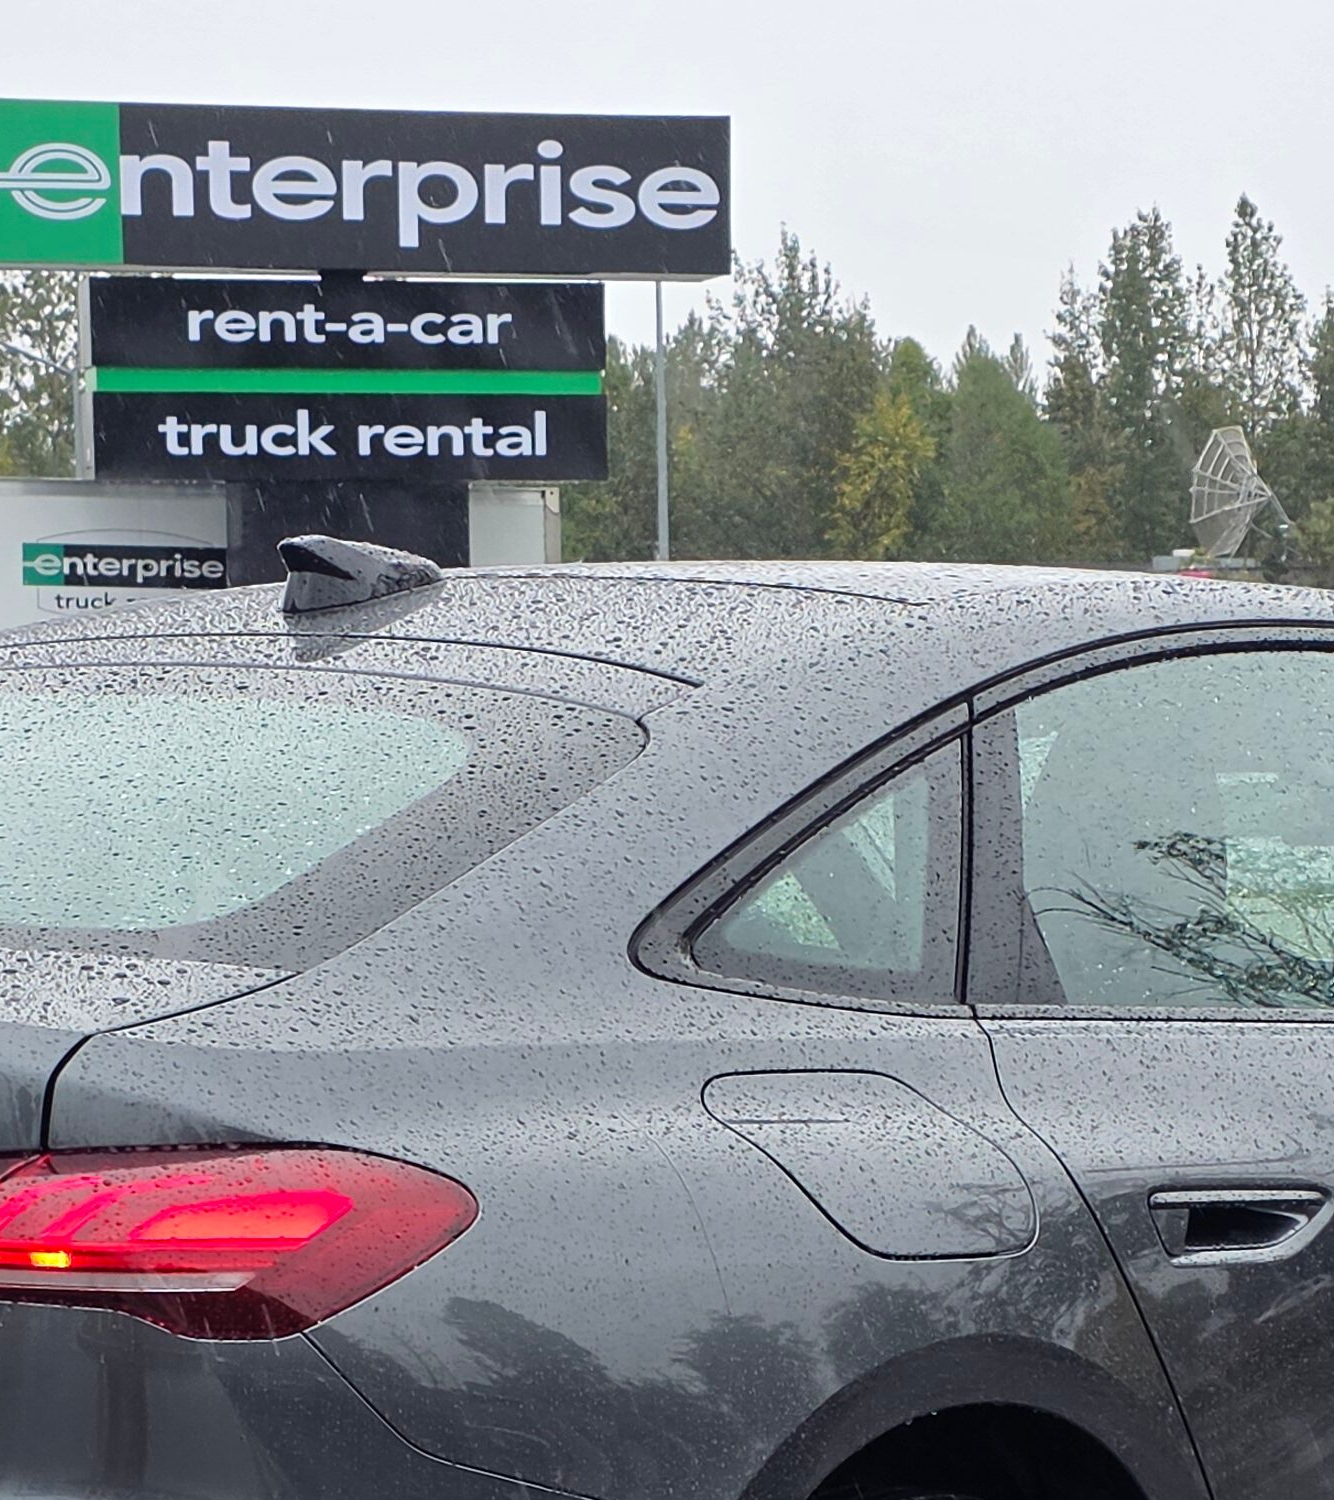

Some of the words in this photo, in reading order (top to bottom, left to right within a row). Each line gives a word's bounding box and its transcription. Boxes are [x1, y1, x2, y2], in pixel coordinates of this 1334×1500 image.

[188, 304, 513, 346] rent-a-car
[158, 409, 336, 458] truck
[358, 410, 548, 457] rental
[29, 553, 224, 583] enterprise
